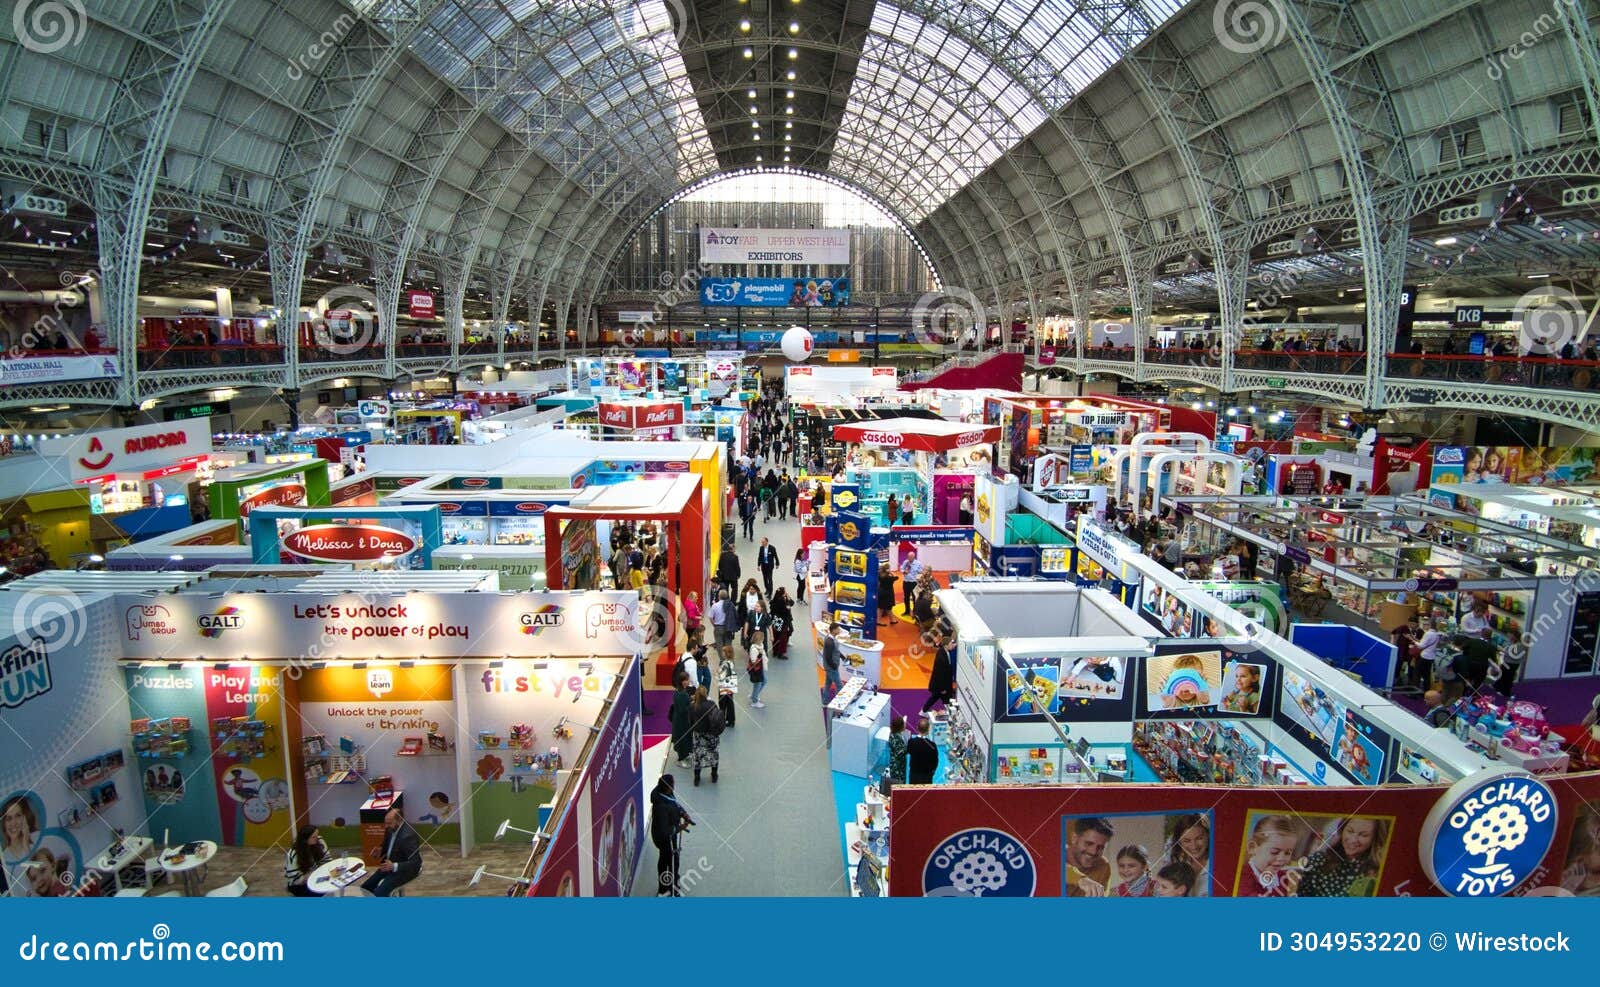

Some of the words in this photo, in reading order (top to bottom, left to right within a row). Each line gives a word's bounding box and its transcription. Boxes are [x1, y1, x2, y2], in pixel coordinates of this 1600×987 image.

[767, 236, 795, 246] UPPER
[798, 236, 821, 246] WEST
[822, 236, 845, 246] HALL
[747, 251, 803, 261] EXHIBITORS
[744, 284, 785, 294] playmobil
[1457, 309, 1481, 323] DKB
[2, 361, 42, 372] NATIONAL
[44, 359, 63, 369] HALL
[646, 409, 668, 423] Flair
[1081, 415, 1095, 425] TOP
[1097, 415, 1126, 425] TRUMPS
[124, 430, 187, 455] AURORA
[862, 431, 902, 445] casdon
[957, 431, 985, 446] casdon
[295, 533, 354, 552] Melissa
[370, 537, 404, 556] Doug
[294, 603, 340, 619] Let's
[346, 603, 407, 619] unlock
[199, 615, 240, 628] GALT
[520, 613, 561, 626] GALT
[324, 625, 348, 635] the
[352, 625, 408, 641] power
[411, 624, 424, 637] of
[428, 622, 469, 640] play
[3, 662, 47, 702] UN
[133, 674, 194, 690] Puzzles
[211, 674, 245, 691] Play
[250, 674, 280, 687] and
[226, 690, 270, 704] Learn
[328, 707, 364, 718] Unlock
[366, 707, 387, 717] the
[389, 709, 424, 720] power
[365, 720, 375, 729] of
[1450, 782, 1551, 829] ORCHARD
[934, 834, 1026, 870] ORCHARD
[1455, 869, 1516, 896] TOYS
